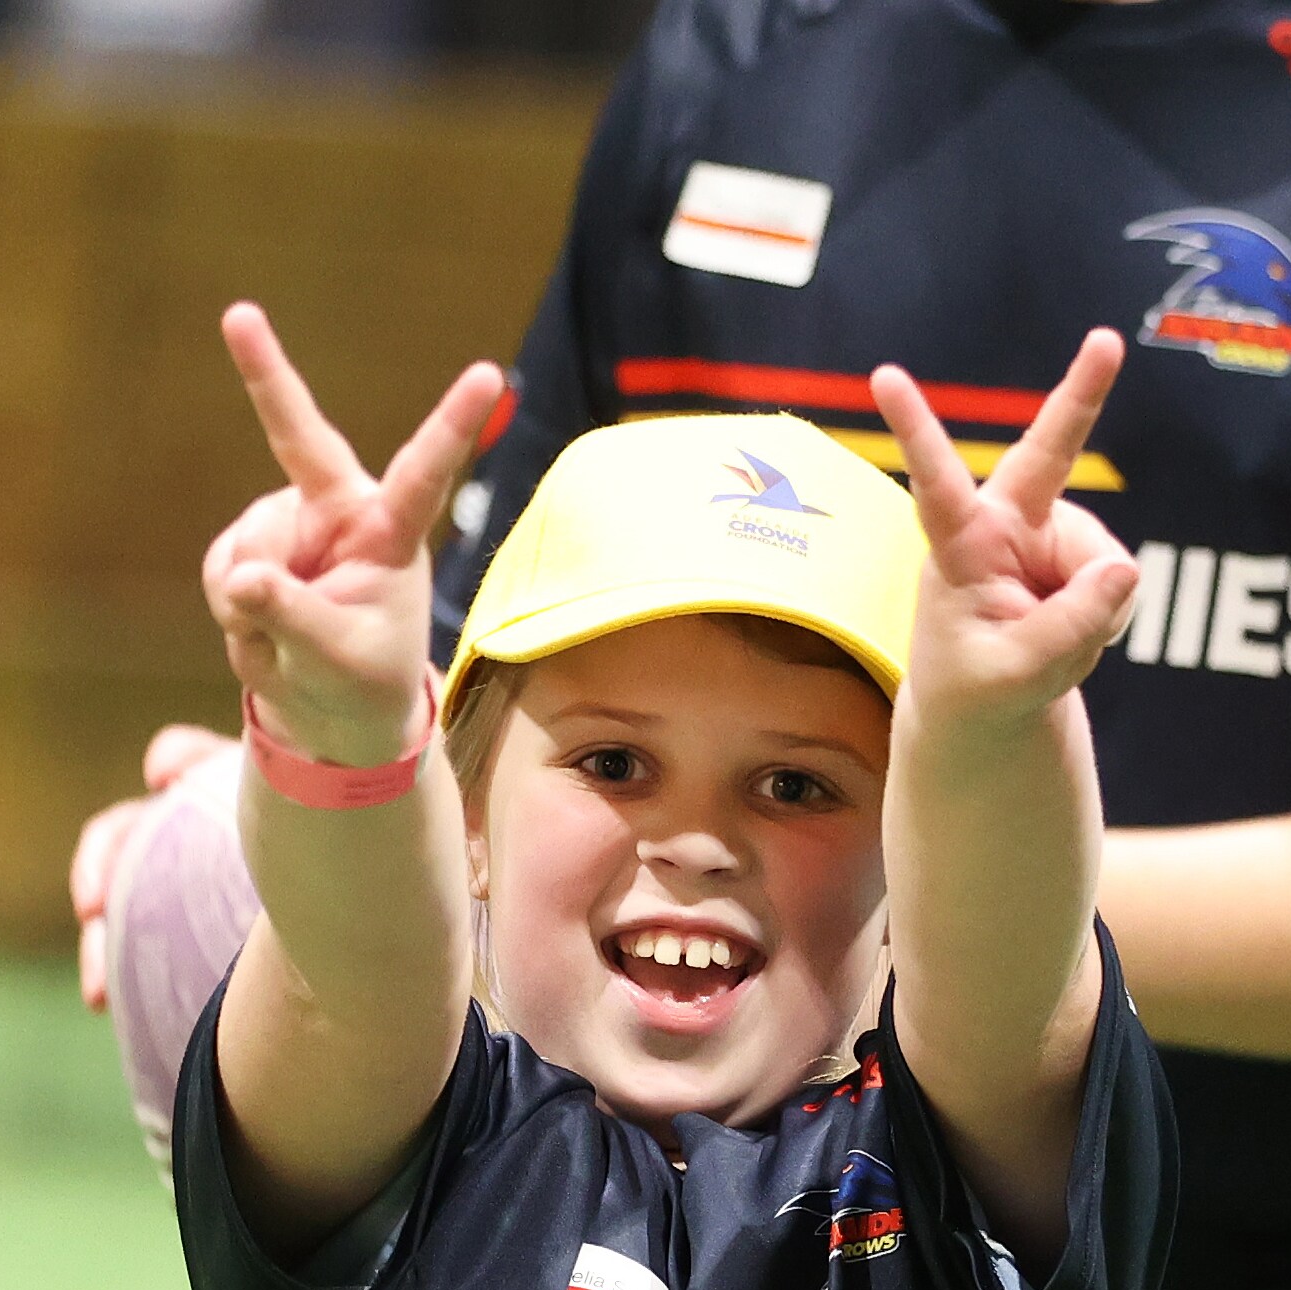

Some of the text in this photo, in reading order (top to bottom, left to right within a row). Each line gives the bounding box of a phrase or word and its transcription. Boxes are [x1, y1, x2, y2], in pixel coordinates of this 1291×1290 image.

[726, 531, 808, 558] FOUNDATION
[728, 520, 809, 551] CROWS
[841, 1232, 896, 1258] ROWS
